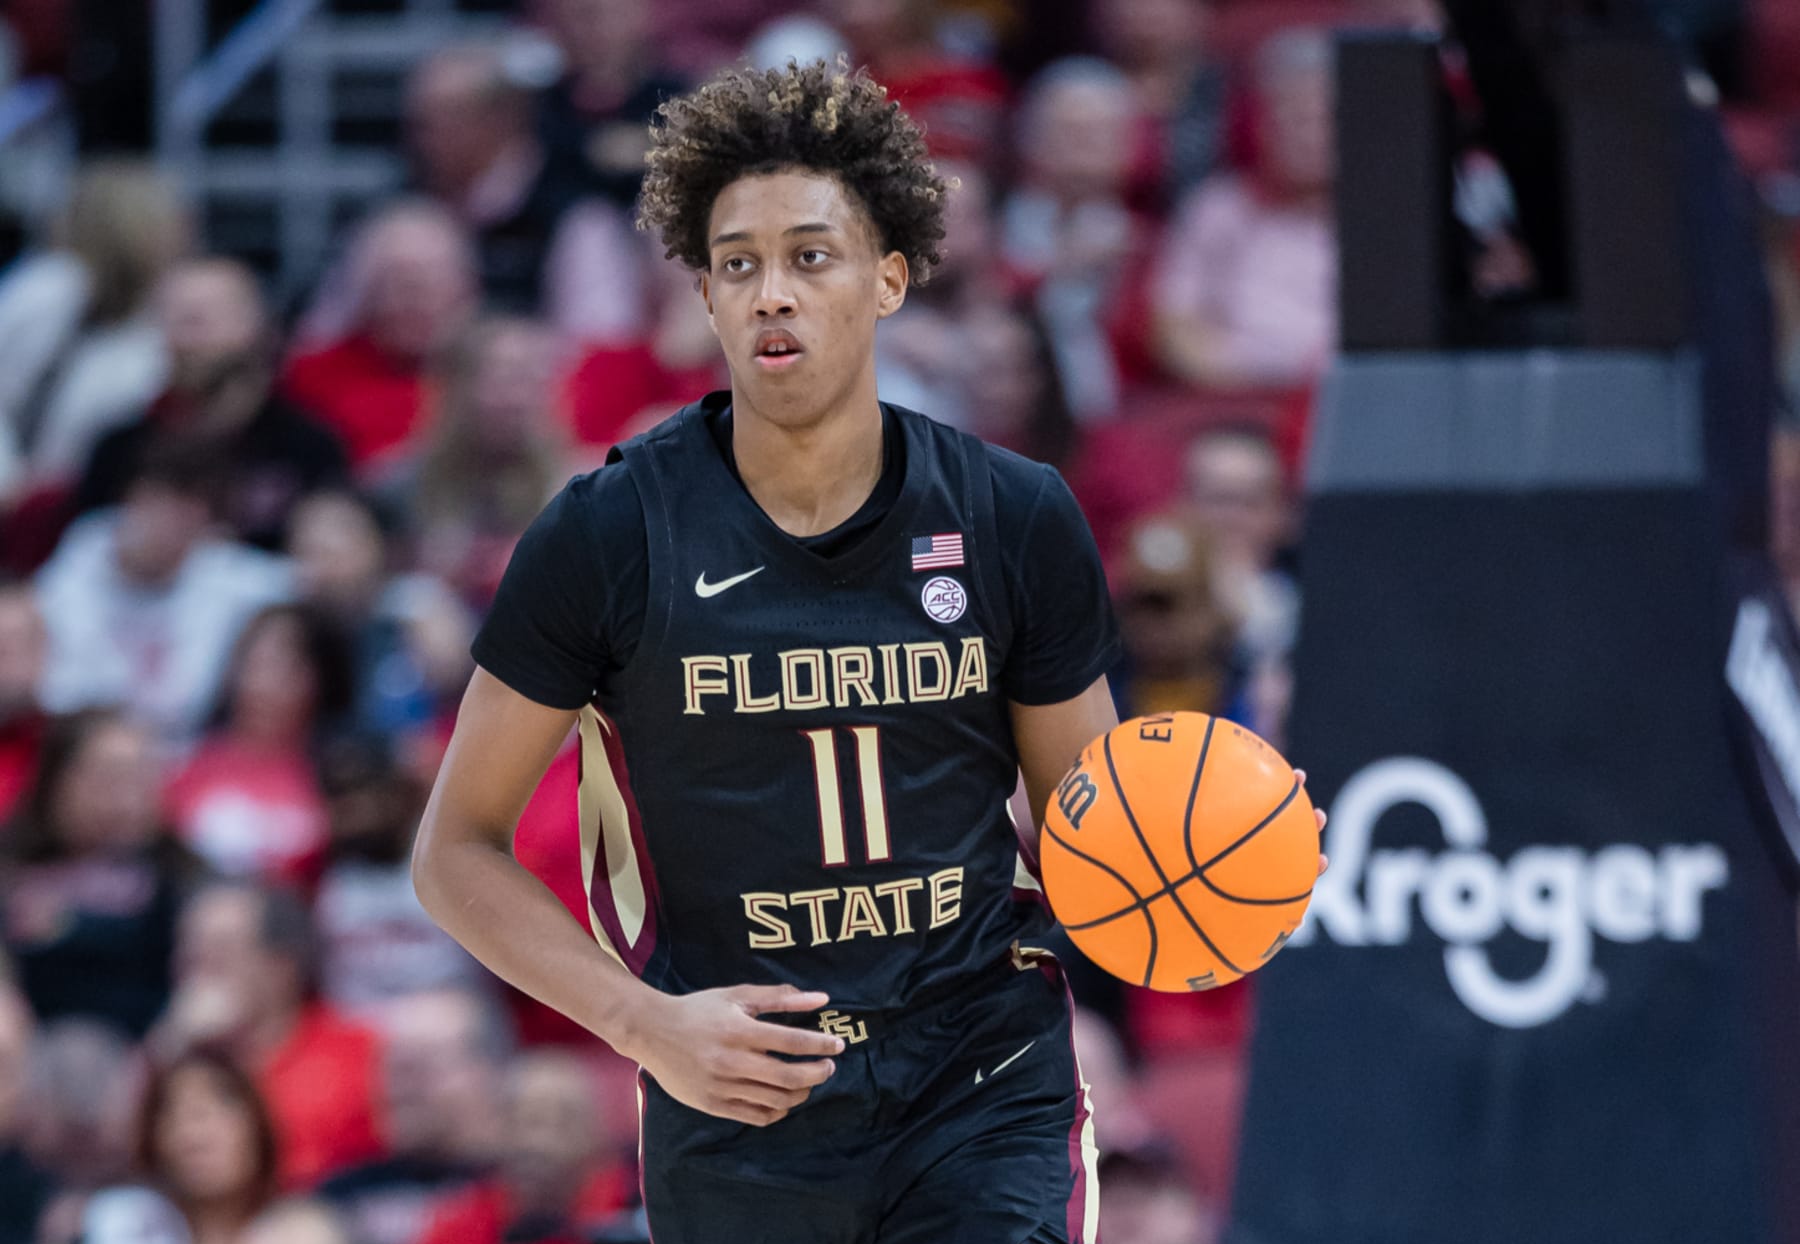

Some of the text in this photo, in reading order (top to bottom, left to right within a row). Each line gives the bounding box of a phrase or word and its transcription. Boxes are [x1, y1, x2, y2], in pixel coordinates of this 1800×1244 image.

[931, 591, 961, 604] ACC
[681, 637, 988, 715] FLORIDA
[801, 725, 892, 868] 11
[740, 866, 964, 949] STATE
[818, 1009, 869, 1044] FSU
